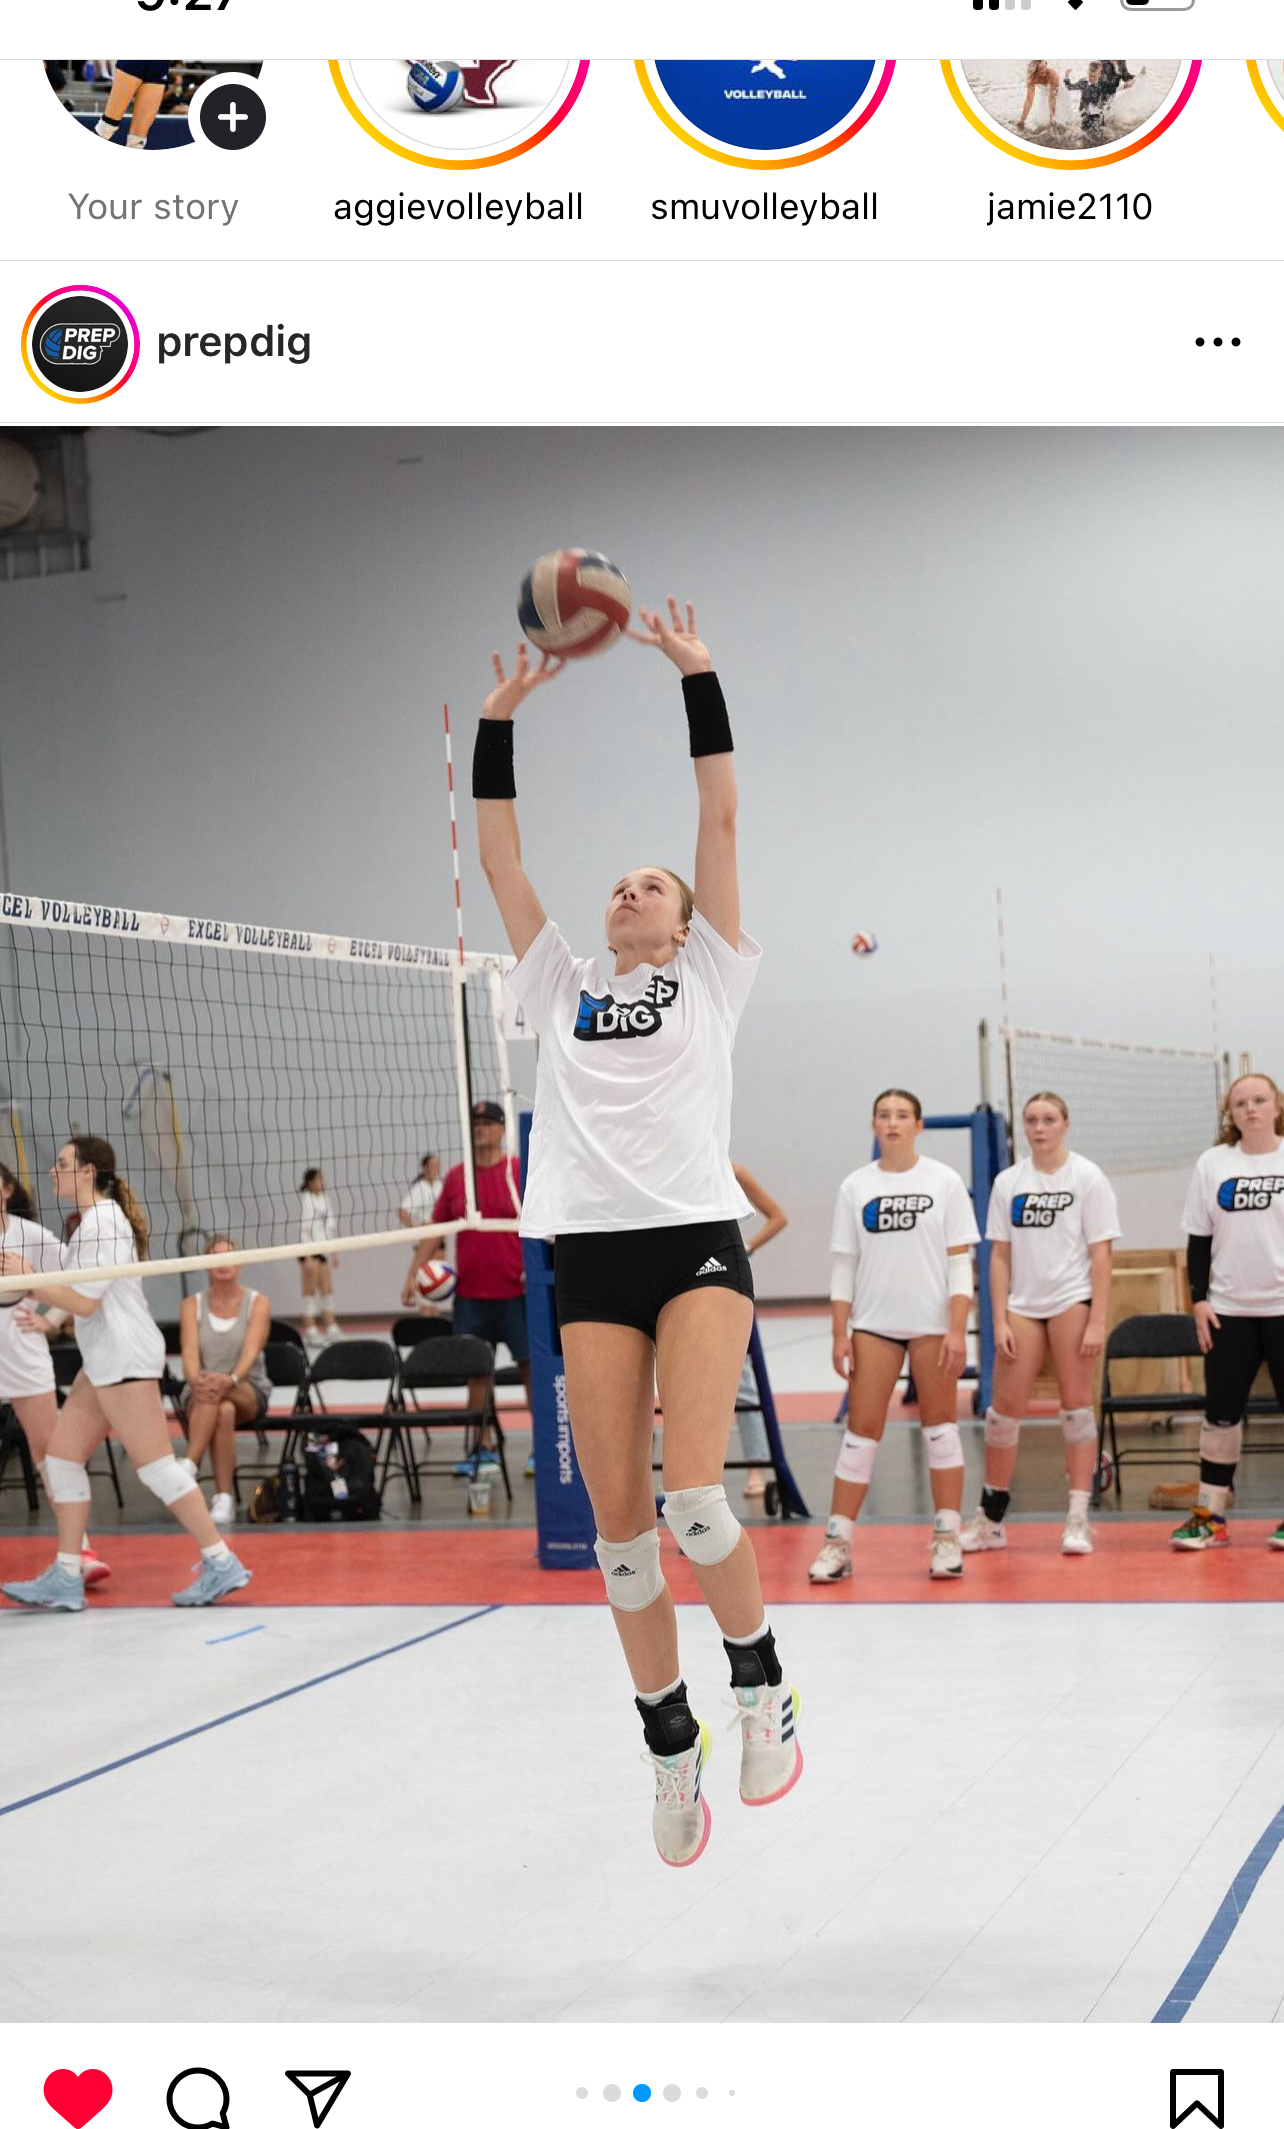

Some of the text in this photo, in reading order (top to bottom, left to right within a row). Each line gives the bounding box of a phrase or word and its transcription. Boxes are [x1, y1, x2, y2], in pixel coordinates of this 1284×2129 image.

[2, 894, 140, 931] CEL VOLLEYBALL
[188, 919, 313, 951] EXCEL VOLLEYBALL
[1235, 1177, 1284, 1192] PREP
[879, 1196, 932, 1212] PREP
[1025, 1194, 1072, 1209] PREP
[1233, 1192, 1270, 1209] DIG
[878, 1211, 914, 1230] DIG
[1022, 1209, 1054, 1226] DIG
[695, 1265, 727, 1277] adidas
